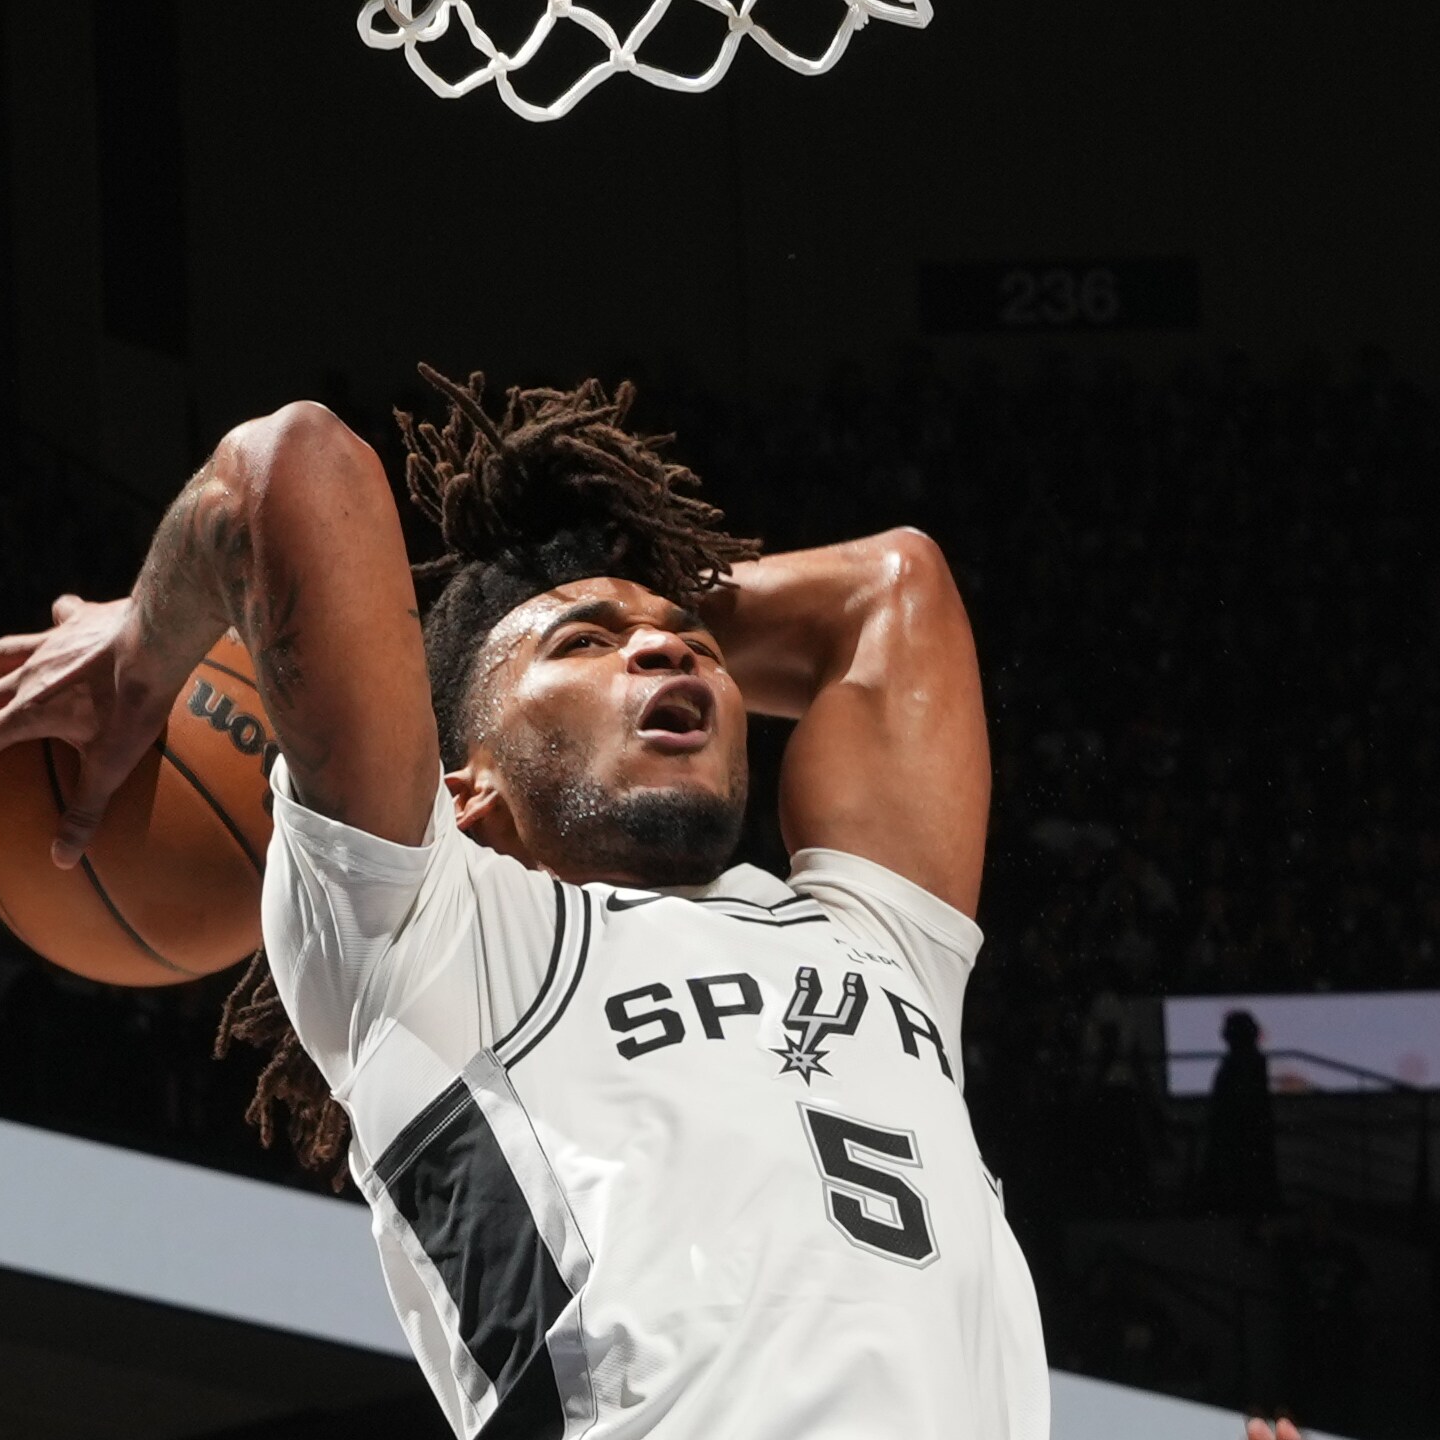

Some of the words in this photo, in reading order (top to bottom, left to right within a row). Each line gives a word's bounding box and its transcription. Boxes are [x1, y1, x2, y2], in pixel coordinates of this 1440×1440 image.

[998, 268, 1120, 323] 236
[604, 964, 956, 1087] SPUR
[796, 1100, 940, 1270] 5
